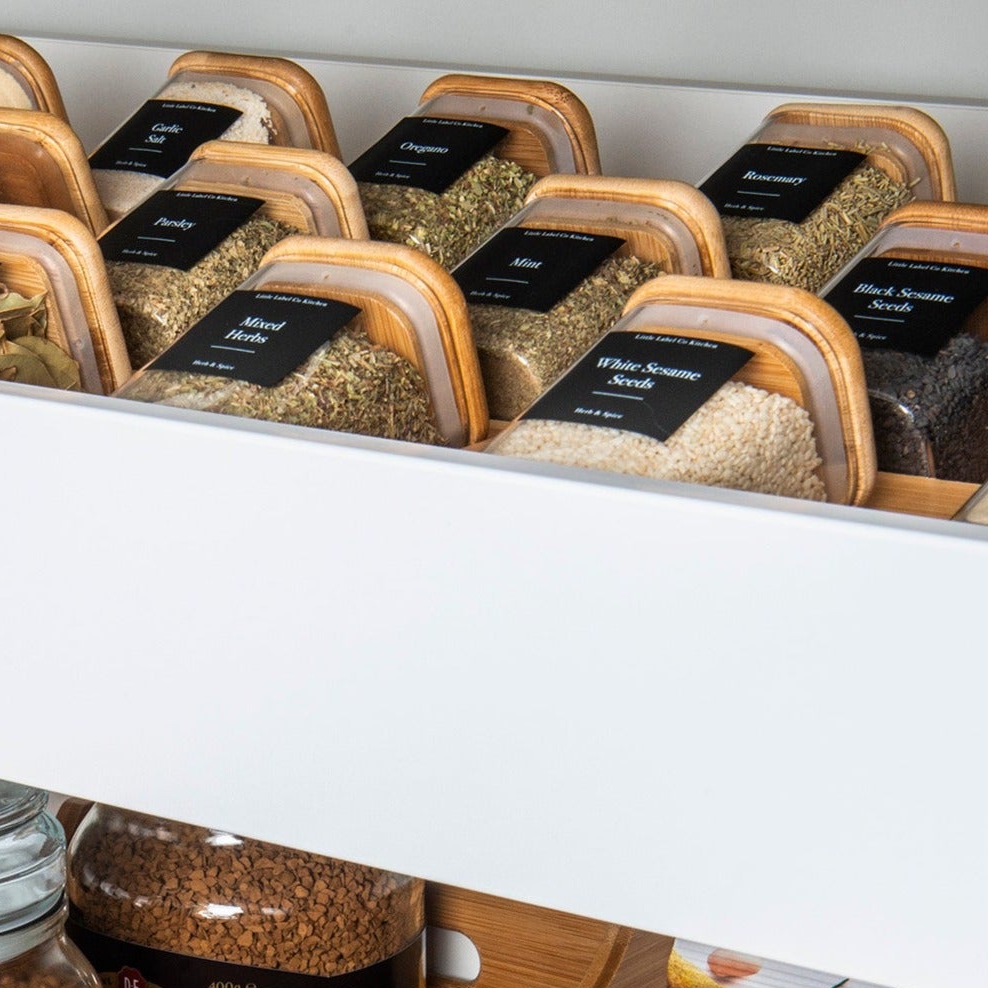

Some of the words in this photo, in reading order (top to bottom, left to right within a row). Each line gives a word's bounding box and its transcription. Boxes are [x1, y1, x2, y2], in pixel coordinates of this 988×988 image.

[151, 123, 184, 134] Garlic
[144, 134, 168, 144] Salt
[399, 141, 449, 155] Oregano
[741, 170, 808, 186] Rosemary
[153, 216, 197, 231] Parsley
[509, 257, 543, 269] Mint
[908, 263, 929, 271] Label
[274, 295, 291, 303] Label
[853, 282, 896, 298] Black
[896, 287, 955, 304] Sesame
[867, 299, 914, 313] Seeds
[238, 316, 287, 332] Mixed
[224, 329, 269, 345] Herbs
[635, 333, 655, 342] Little
[656, 335, 677, 344] Label
[688, 339, 719, 349] Kitchen
[596, 356, 643, 373] White
[641, 362, 702, 381] Sesame
[607, 374, 656, 390] Seeds
[574, 406, 593, 416] Herb
[594, 409, 602, 417] &
[603, 410, 624, 420] Spice
